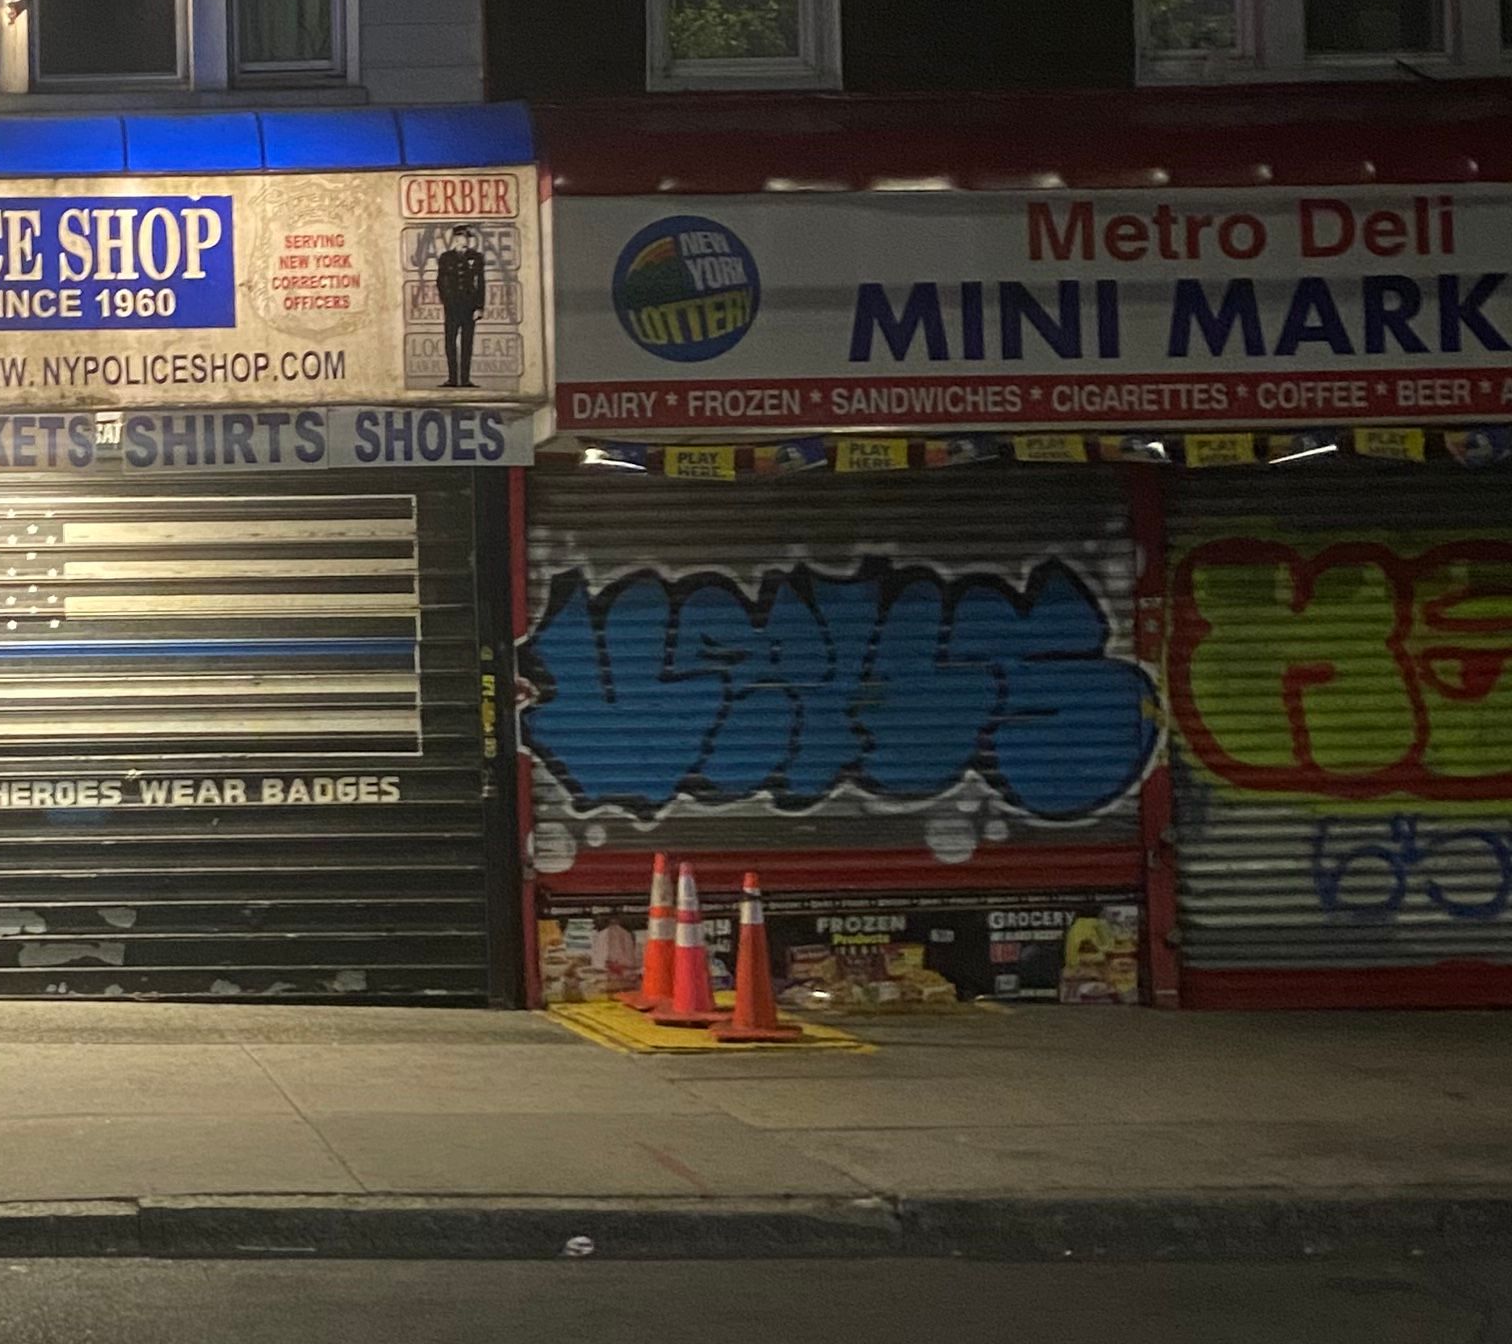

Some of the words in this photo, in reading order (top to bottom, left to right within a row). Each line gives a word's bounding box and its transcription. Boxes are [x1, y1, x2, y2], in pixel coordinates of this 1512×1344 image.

[405, 179, 512, 214] GERBER
[285, 234, 344, 249] SERVING
[1028, 201, 1267, 261] Metro
[1301, 196, 1455, 257] Deli
[58, 206, 222, 282] SHOP
[679, 232, 730, 256] NEW
[279, 255, 308, 269] NEW
[314, 255, 352, 269] YORK
[685, 256, 747, 290] YORK
[271, 275, 361, 290] CORRECTION
[94, 287, 176, 318] 1960
[284, 294, 351, 310] OFFICERS
[849, 280, 1120, 361] MINI
[1168, 271, 1512, 357] MARK
[573, 392, 659, 419] DAIRY
[687, 389, 800, 416] FROZEN
[831, 384, 1022, 413] SANDWICHES
[1052, 382, 1229, 412] CIGARETTES
[1257, 380, 1368, 408] COFFEE
[1396, 377, 1472, 405] BEER
[124, 411, 326, 468] SHIRTS
[354, 410, 505, 463] SHOES
[138, 778, 246, 804] WEAR
[261, 776, 400, 803] BADGES
[816, 915, 906, 933] FROZEN
[989, 911, 1075, 929] GROCERY
